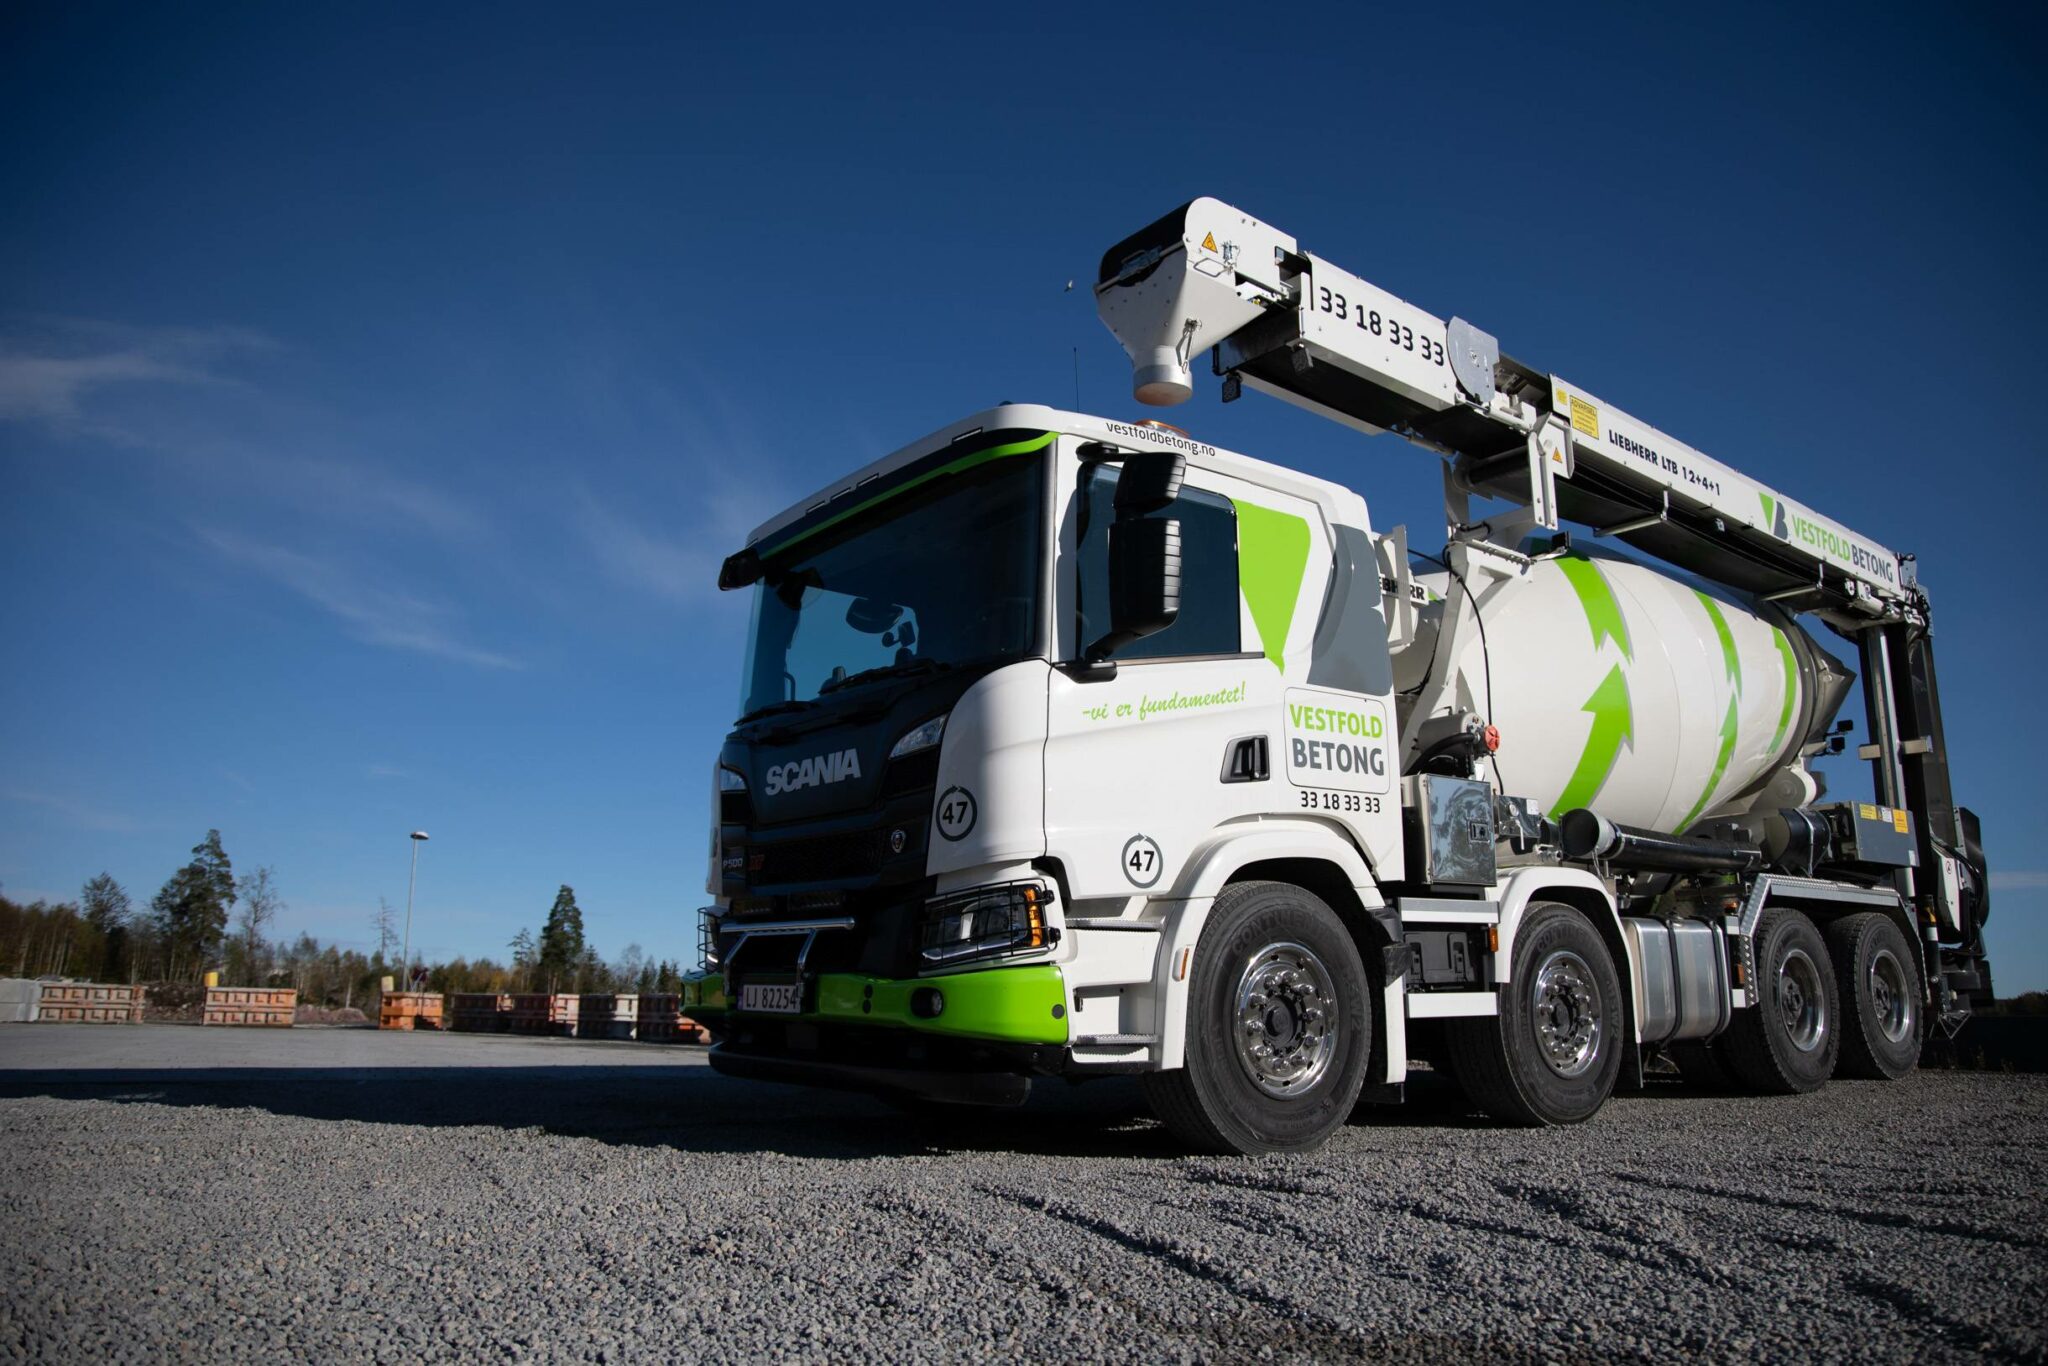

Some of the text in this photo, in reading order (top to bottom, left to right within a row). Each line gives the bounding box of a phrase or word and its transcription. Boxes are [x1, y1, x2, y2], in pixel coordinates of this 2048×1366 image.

[1320, 286, 1445, 367] 33 18 33 33
[1105, 422, 1216, 457] vestfoldbetong.no
[1608, 429, 1721, 496] LIEBHERR LTB 12+4+1
[1115, 702, 1133, 718] er
[1139, 680, 1247, 722] fundamentet!
[1289, 703, 1383, 739] VESTFOLD
[764, 748, 862, 797] SCANIA
[1291, 737, 1385, 776] BETONG
[941, 800, 968, 825] 47
[1300, 790, 1381, 814] 33 18 33 33
[1129, 850, 1155, 872] 47
